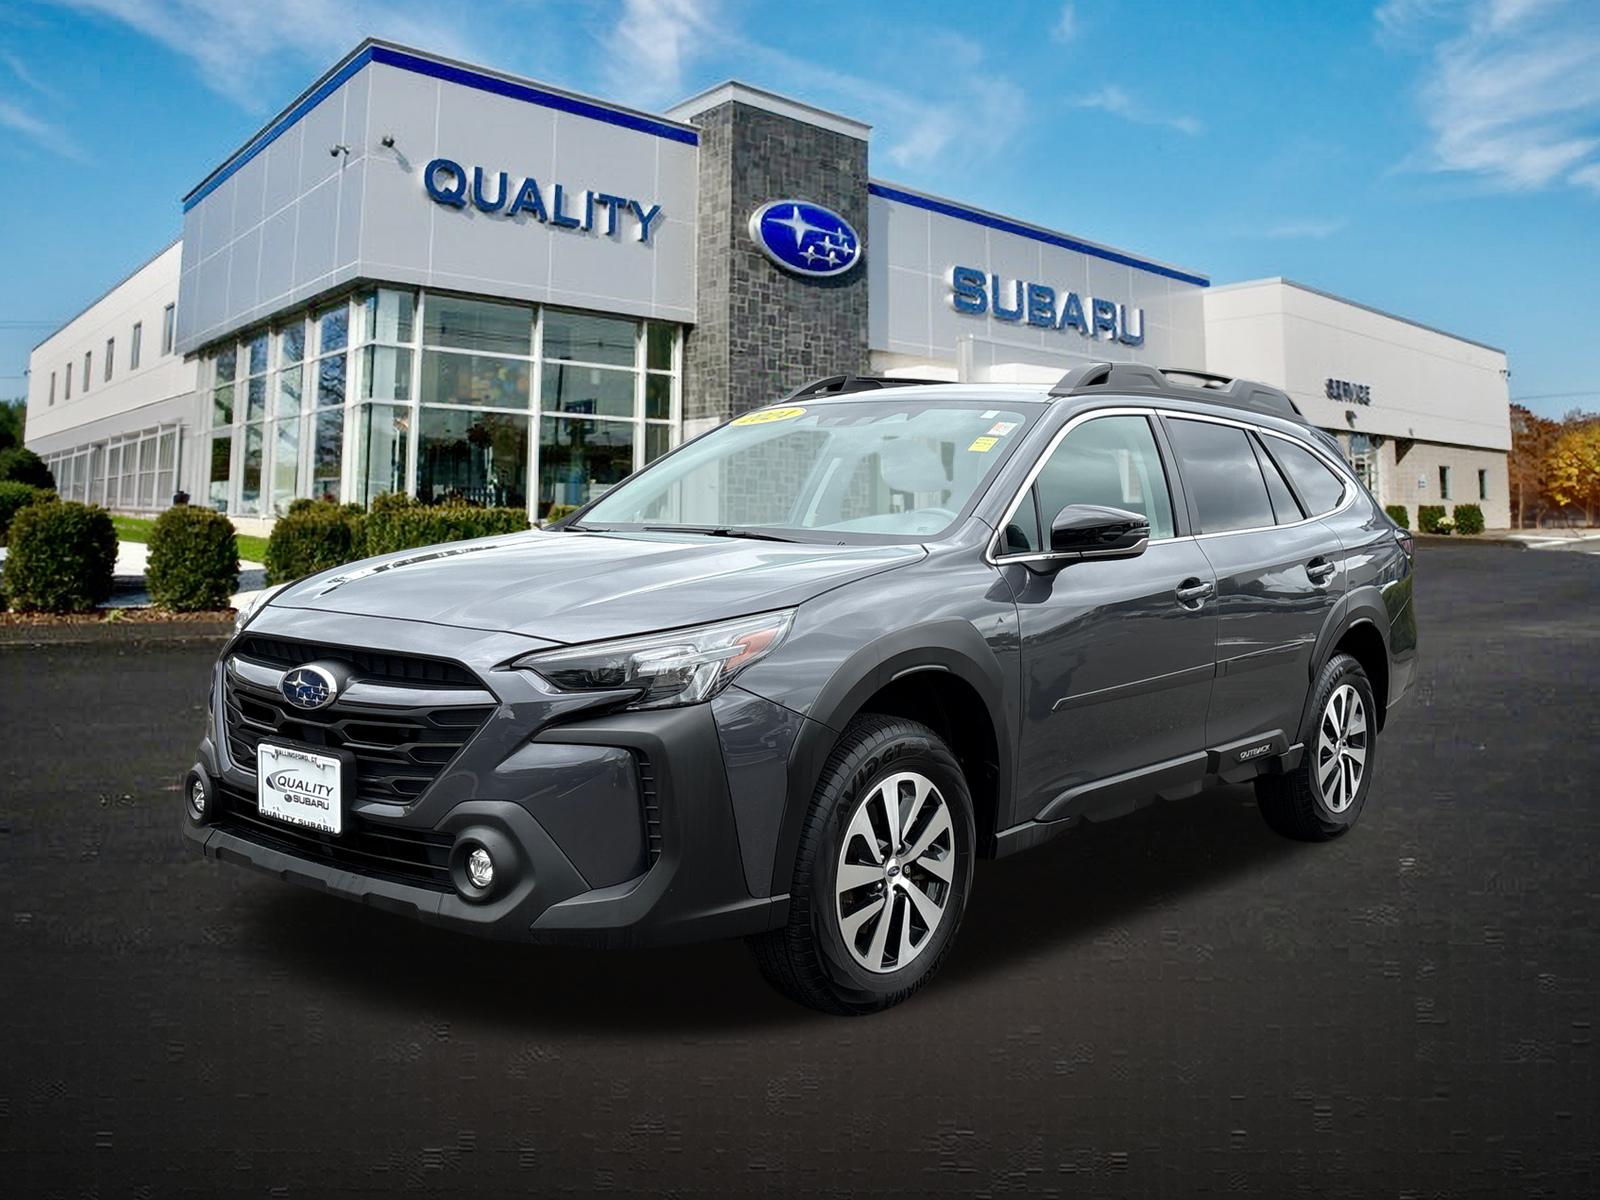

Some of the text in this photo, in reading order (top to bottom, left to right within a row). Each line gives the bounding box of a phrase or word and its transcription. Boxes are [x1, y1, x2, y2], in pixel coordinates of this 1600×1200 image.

[424, 158, 661, 243] QUALITY
[947, 265, 1145, 347] SUBARU
[882, 741, 906, 764] GT
[277, 776, 334, 796] QUALITY
[293, 794, 330, 811] SUBARU
[261, 808, 336, 833] QUALITY SUBARU
